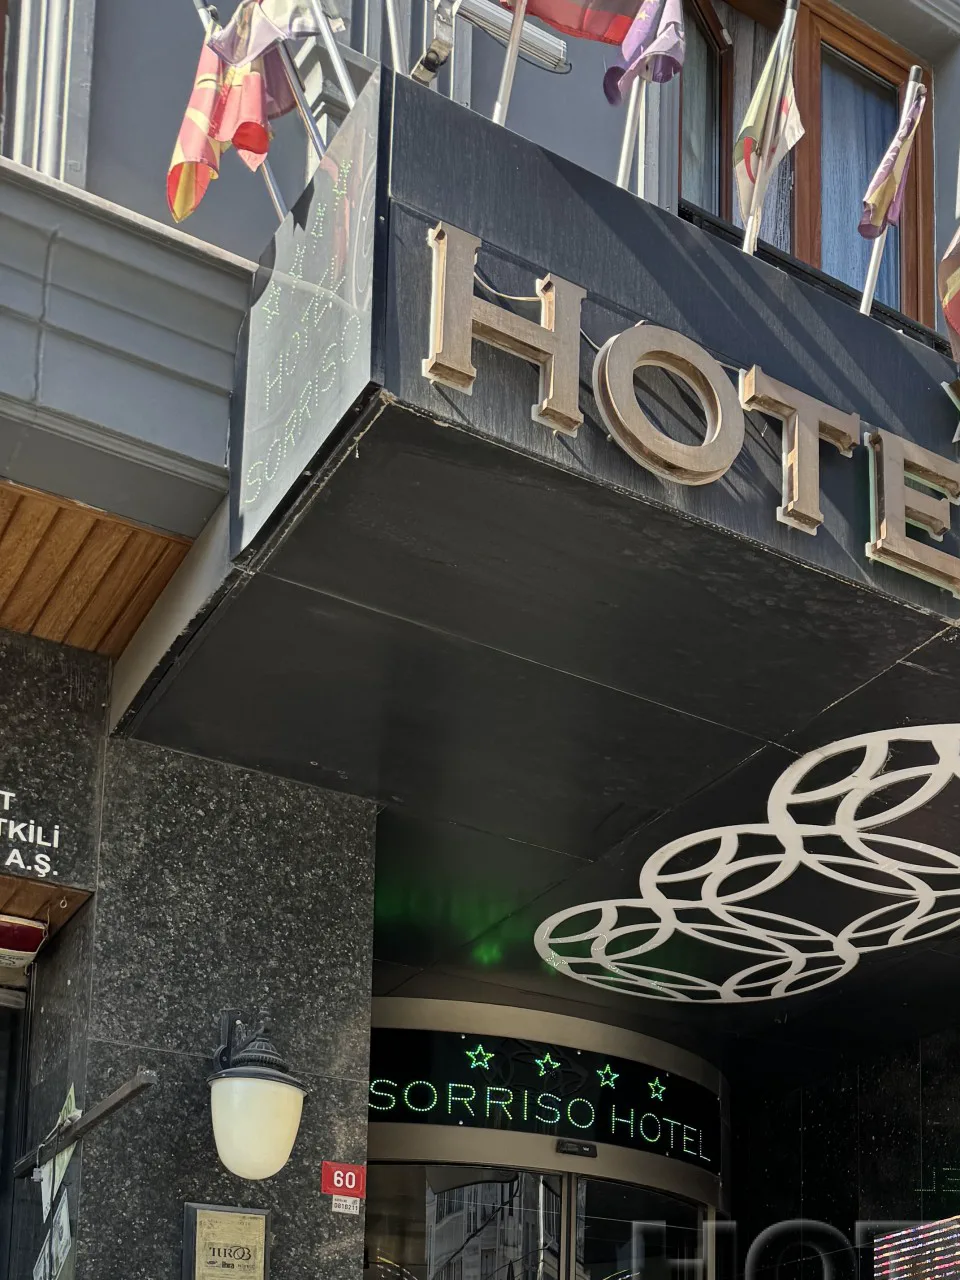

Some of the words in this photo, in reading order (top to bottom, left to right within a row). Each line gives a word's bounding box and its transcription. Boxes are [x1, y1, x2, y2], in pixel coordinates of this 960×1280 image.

[4, 848, 59, 878] A.Ş.
[368, 1078, 596, 1130] SORRISO
[610, 1103, 712, 1162] HOTEL
[333, 1170, 356, 1189] 60
